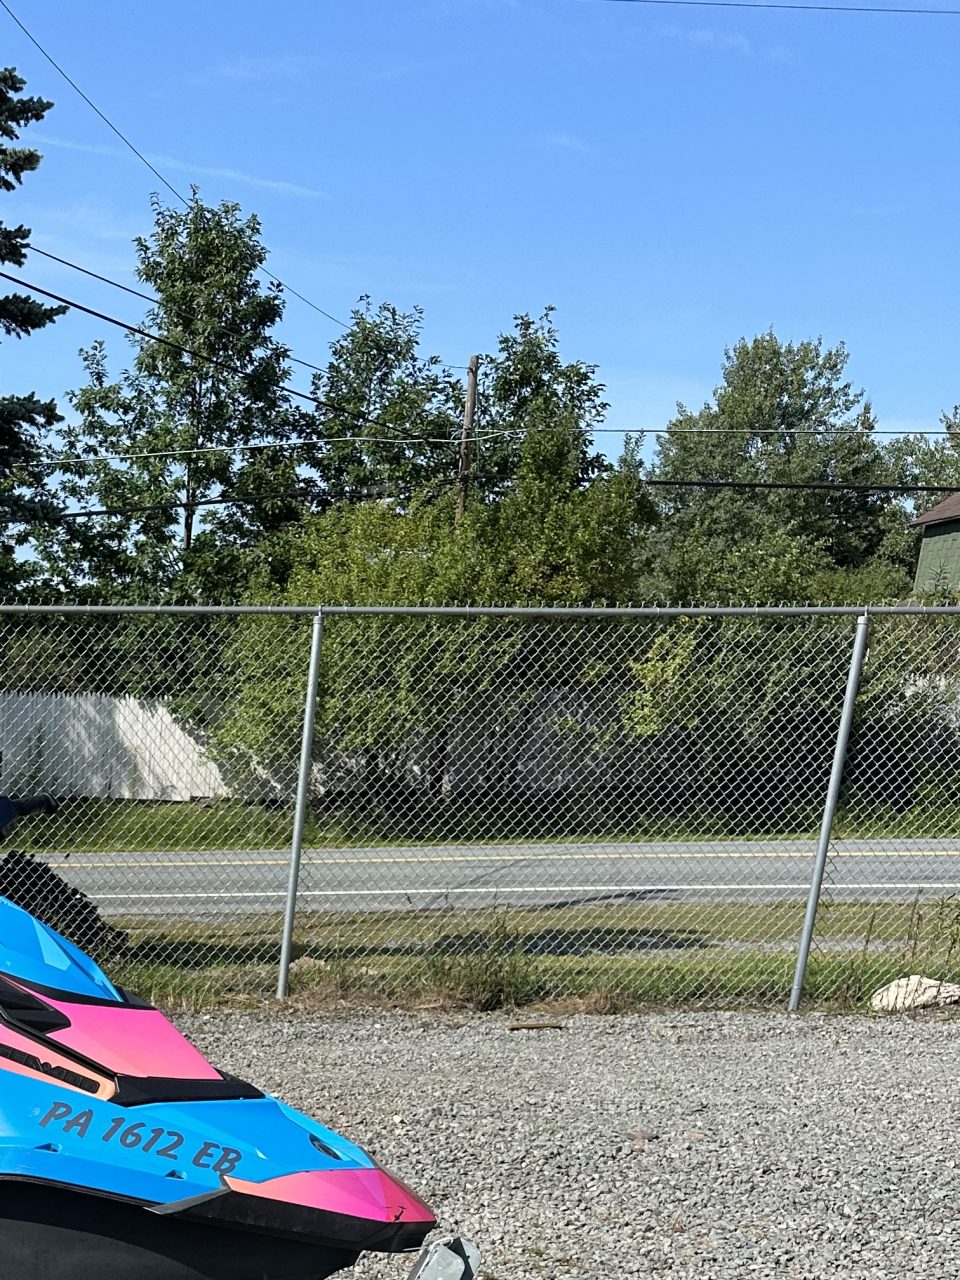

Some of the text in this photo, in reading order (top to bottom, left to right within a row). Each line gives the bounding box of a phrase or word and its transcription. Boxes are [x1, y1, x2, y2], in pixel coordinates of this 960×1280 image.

[38, 1101, 243, 1175] PA 1612 EB
